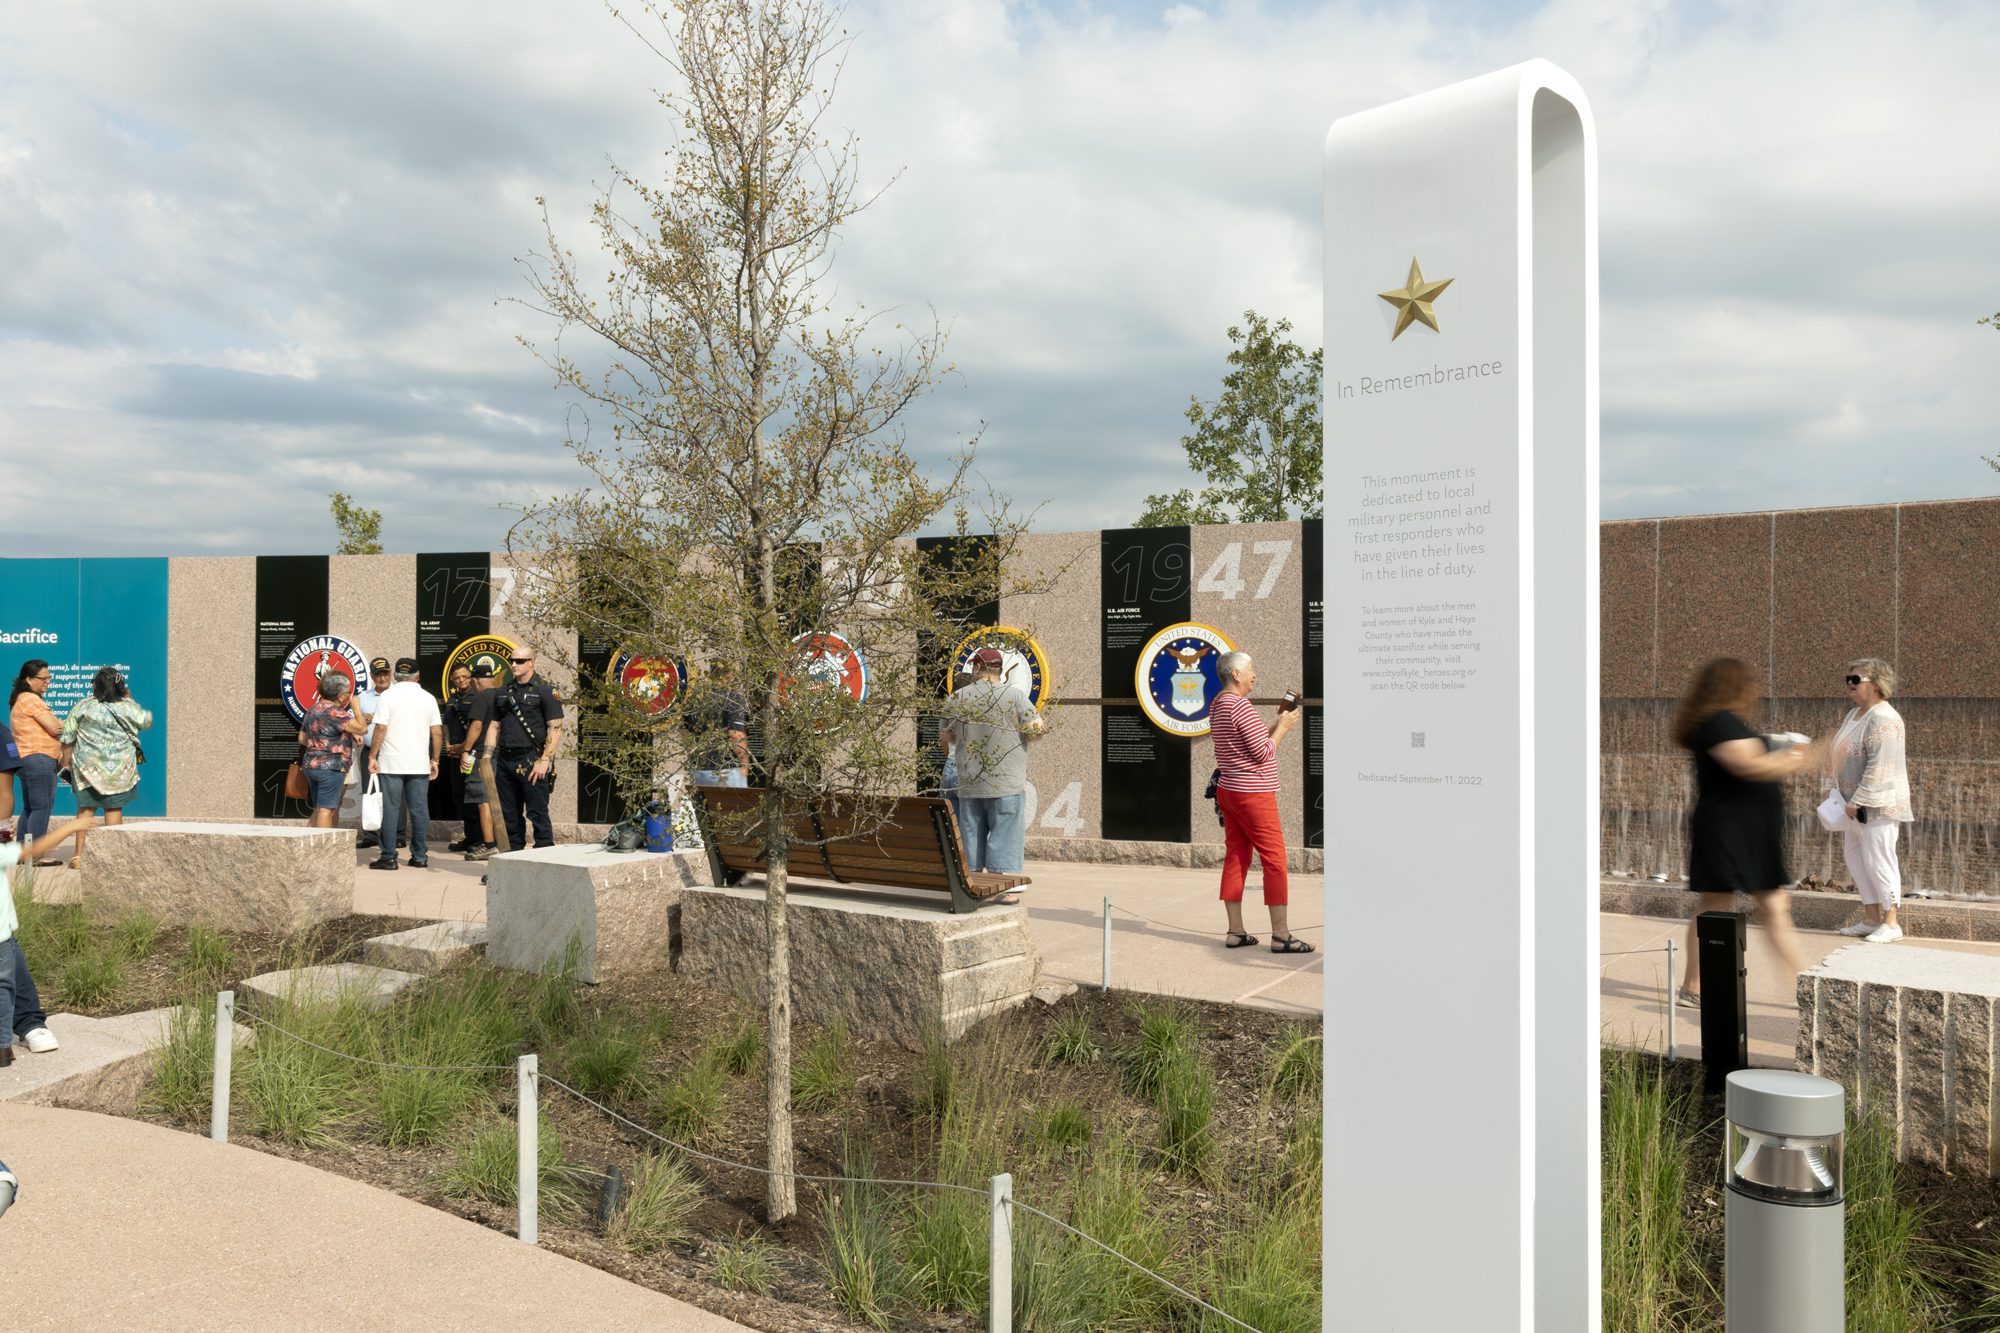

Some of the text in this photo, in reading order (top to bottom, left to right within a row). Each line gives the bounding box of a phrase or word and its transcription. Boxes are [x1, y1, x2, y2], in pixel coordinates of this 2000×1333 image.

[1338, 361, 1502, 398] In Remembrance
[1362, 466, 1476, 488] This monument is
[1362, 484, 1475, 507] dedicated to local
[1348, 500, 1491, 527] military personnel and
[1355, 522, 1484, 544] first responders who
[1355, 542, 1485, 564] have given their lives
[1111, 540, 1293, 603] 1947
[1362, 562, 1475, 581] in the line of duty.
[1362, 606, 1371, 614] To
[1373, 606, 1392, 614] learn
[1416, 603, 1440, 612] about
[1442, 603, 1455, 611] the
[1362, 615, 1476, 627] and women of Kyle and Hays
[1155, 628, 1188, 648] UNITED
[1190, 628, 1223, 647] STATES
[1365, 628, 1472, 641] County who have made the
[1358, 641, 1480, 653] ultimate sacrifice while serving
[282, 638, 334, 680] NATIONAL
[336, 641, 367, 682] GUARD
[1376, 656, 1394, 664] their
[1444, 655, 1461, 663] visit
[64, 682, 71, 690] of
[1371, 682, 1389, 690] scan
[1391, 681, 1404, 690] the
[1406, 680, 1418, 692] QR
[1420, 680, 1439, 689] code
[287, 696, 305, 718] ALWAYS
[1165, 719, 1179, 730] AIR
[1358, 772, 1482, 785] Dedicated September 11, 2022
